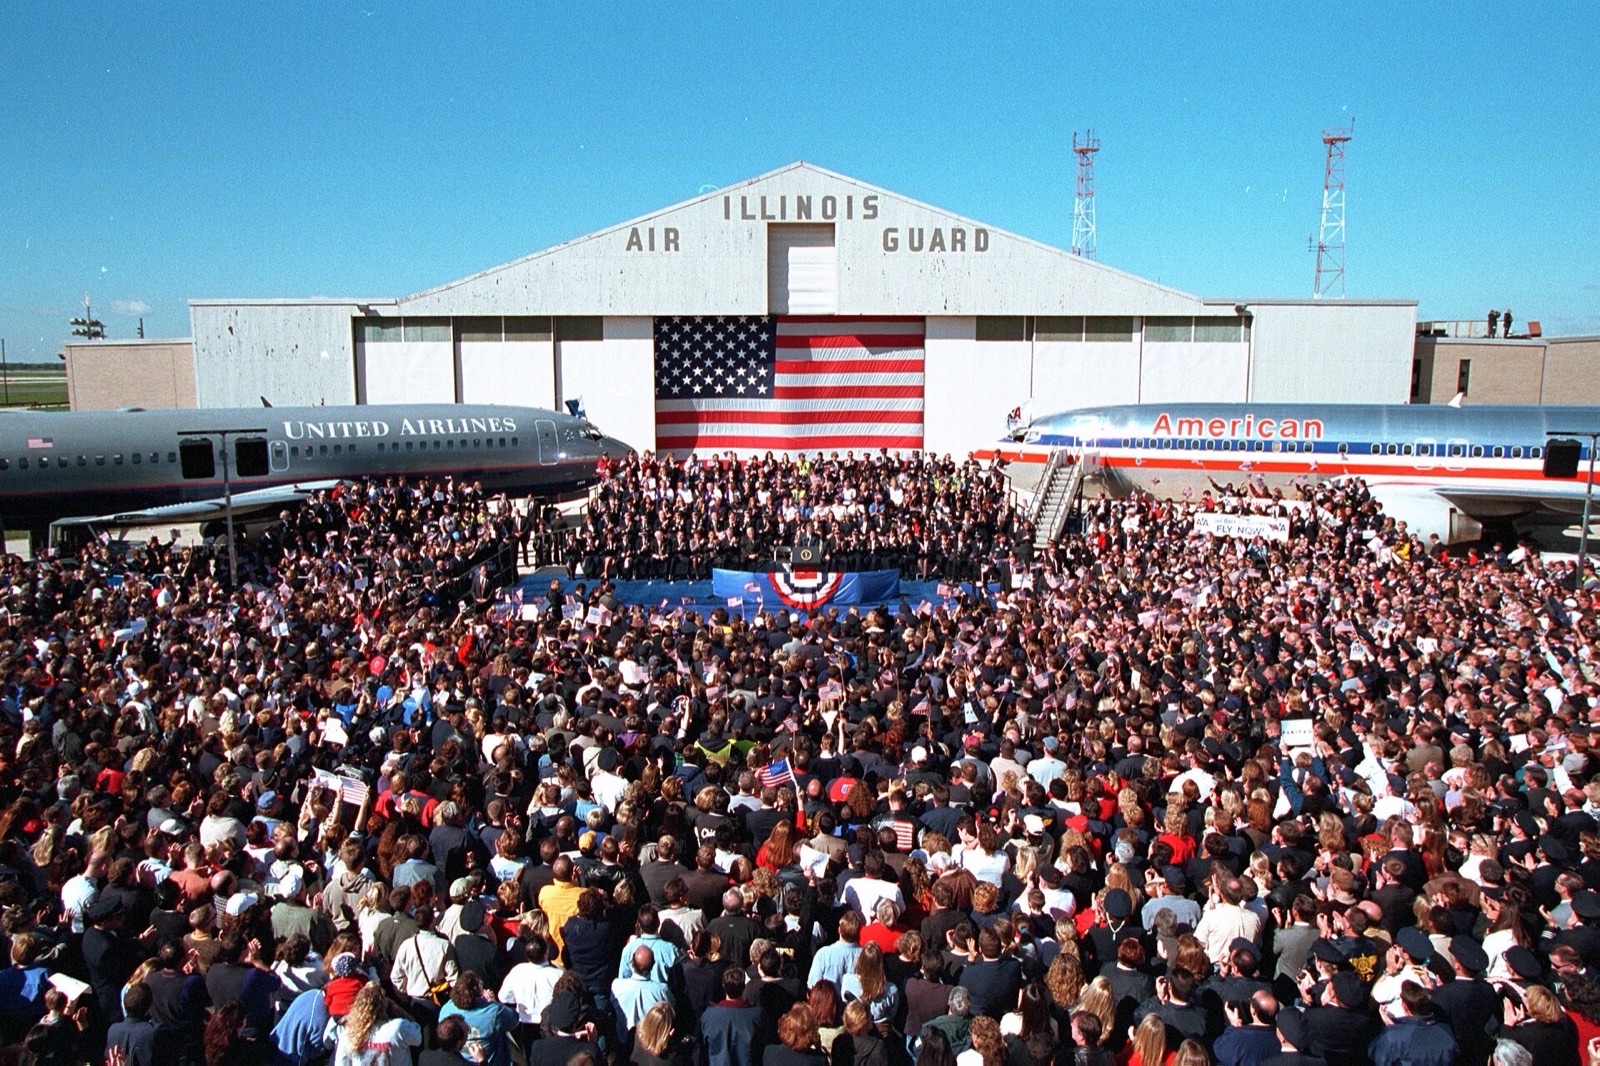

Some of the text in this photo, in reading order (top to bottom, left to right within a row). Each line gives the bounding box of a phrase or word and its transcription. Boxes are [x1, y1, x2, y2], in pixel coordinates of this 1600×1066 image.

[723, 195, 879, 220] ILLINOIS
[625, 227, 680, 252] AIR
[883, 227, 989, 252] GUARD
[282, 417, 517, 440] UNITED AIRLINES
[1152, 413, 1323, 439] American
[1216, 524, 1233, 534] FLY
